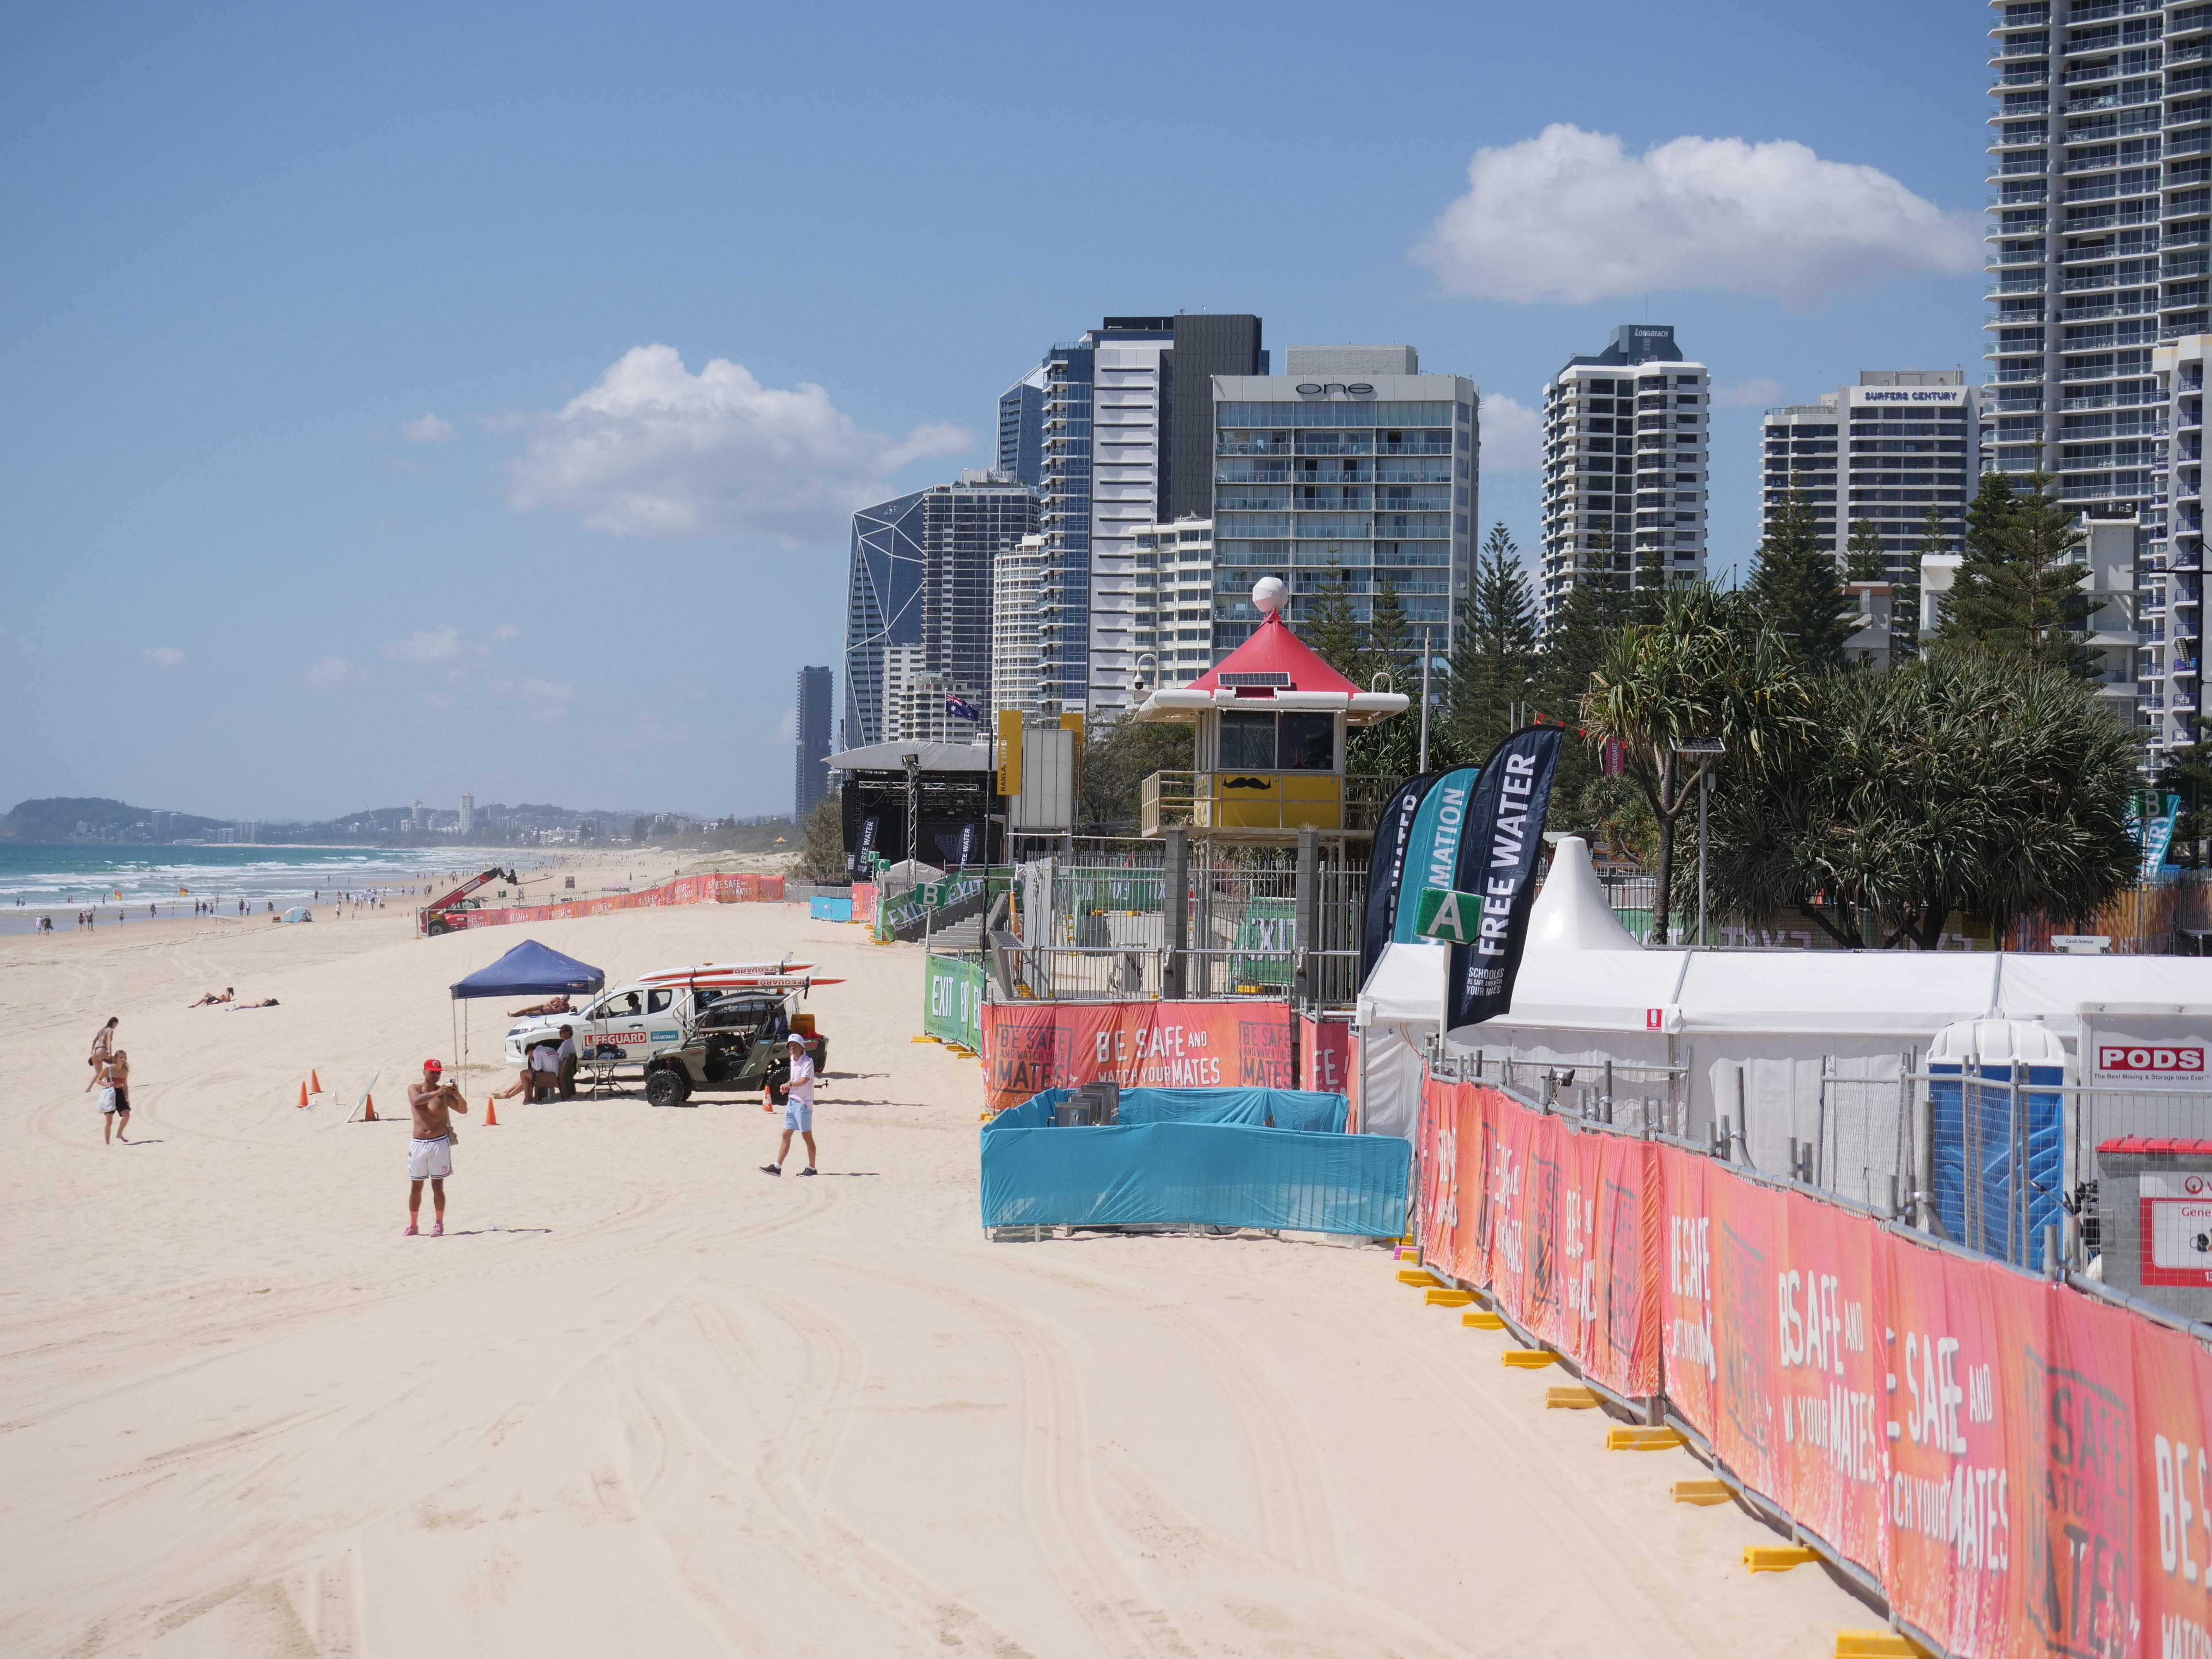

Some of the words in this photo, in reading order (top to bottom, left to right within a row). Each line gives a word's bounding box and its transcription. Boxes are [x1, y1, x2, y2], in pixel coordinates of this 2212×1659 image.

[1634, 328, 1669, 338] LONGBEACH
[1864, 392, 1909, 401] SURFERS
[1912, 392, 1958, 401] CENTURY
[1490, 753, 1536, 868] WATER
[2145, 790, 2160, 816] B
[863, 821, 874, 845] WATER
[860, 846, 869, 864] FREE
[868, 851, 876, 862] D
[878, 860, 886, 871] C
[715, 880, 723, 889] BE
[724, 879, 741, 888] SAFE
[923, 885, 938, 906] B
[949, 879, 984, 905] EXIT
[467, 914, 478, 923] AFE
[1427, 892, 1464, 940] A
[1479, 876, 1515, 956] FREE
[932, 975, 954, 1018] EXIT
[1467, 985, 1484, 996] YOUR
[1001, 1028, 1019, 1048] BE
[1026, 1030, 1066, 1052] SAFE
[1097, 1029, 1128, 1062] BE
[1135, 1025, 1185, 1059] SAFE
[1188, 1031, 1207, 1048] AND
[1244, 1025, 1258, 1046] BE
[1262, 1027, 1291, 1049] SAFE
[999, 1049, 1015, 1059] AND
[1017, 1050, 1044, 1061] WATCH
[1046, 1052, 1065, 1062] YOUR
[1244, 1046, 1256, 1056] AND
[1257, 1048, 1275, 1059] WATCH
[2102, 1048, 2201, 1069] PODS
[997, 1059, 1065, 1090] MATES
[1098, 1068, 1138, 1084] WATCH
[1141, 1066, 1171, 1083] YOUR
[1171, 1057, 1221, 1086] MATES
[1243, 1056, 1292, 1089] MATES
[1682, 1216, 1711, 1301] SAFE
[1788, 1269, 1844, 1375] SAFE
[1844, 1299, 1863, 1352] AND
[1905, 1331, 1966, 1454] SAFE
[1969, 1363, 1993, 1423] AND
[1797, 1394, 1828, 1449] YOUR
[1828, 1382, 1876, 1482] MATES
[2051, 1387, 2123, 1500] SAFE
[2046, 1470, 2095, 1523] ATCH
[2154, 1432, 2197, 1582] BE
[1915, 1473, 1951, 1543] YOUR
[1949, 1463, 2008, 1571] MATES
